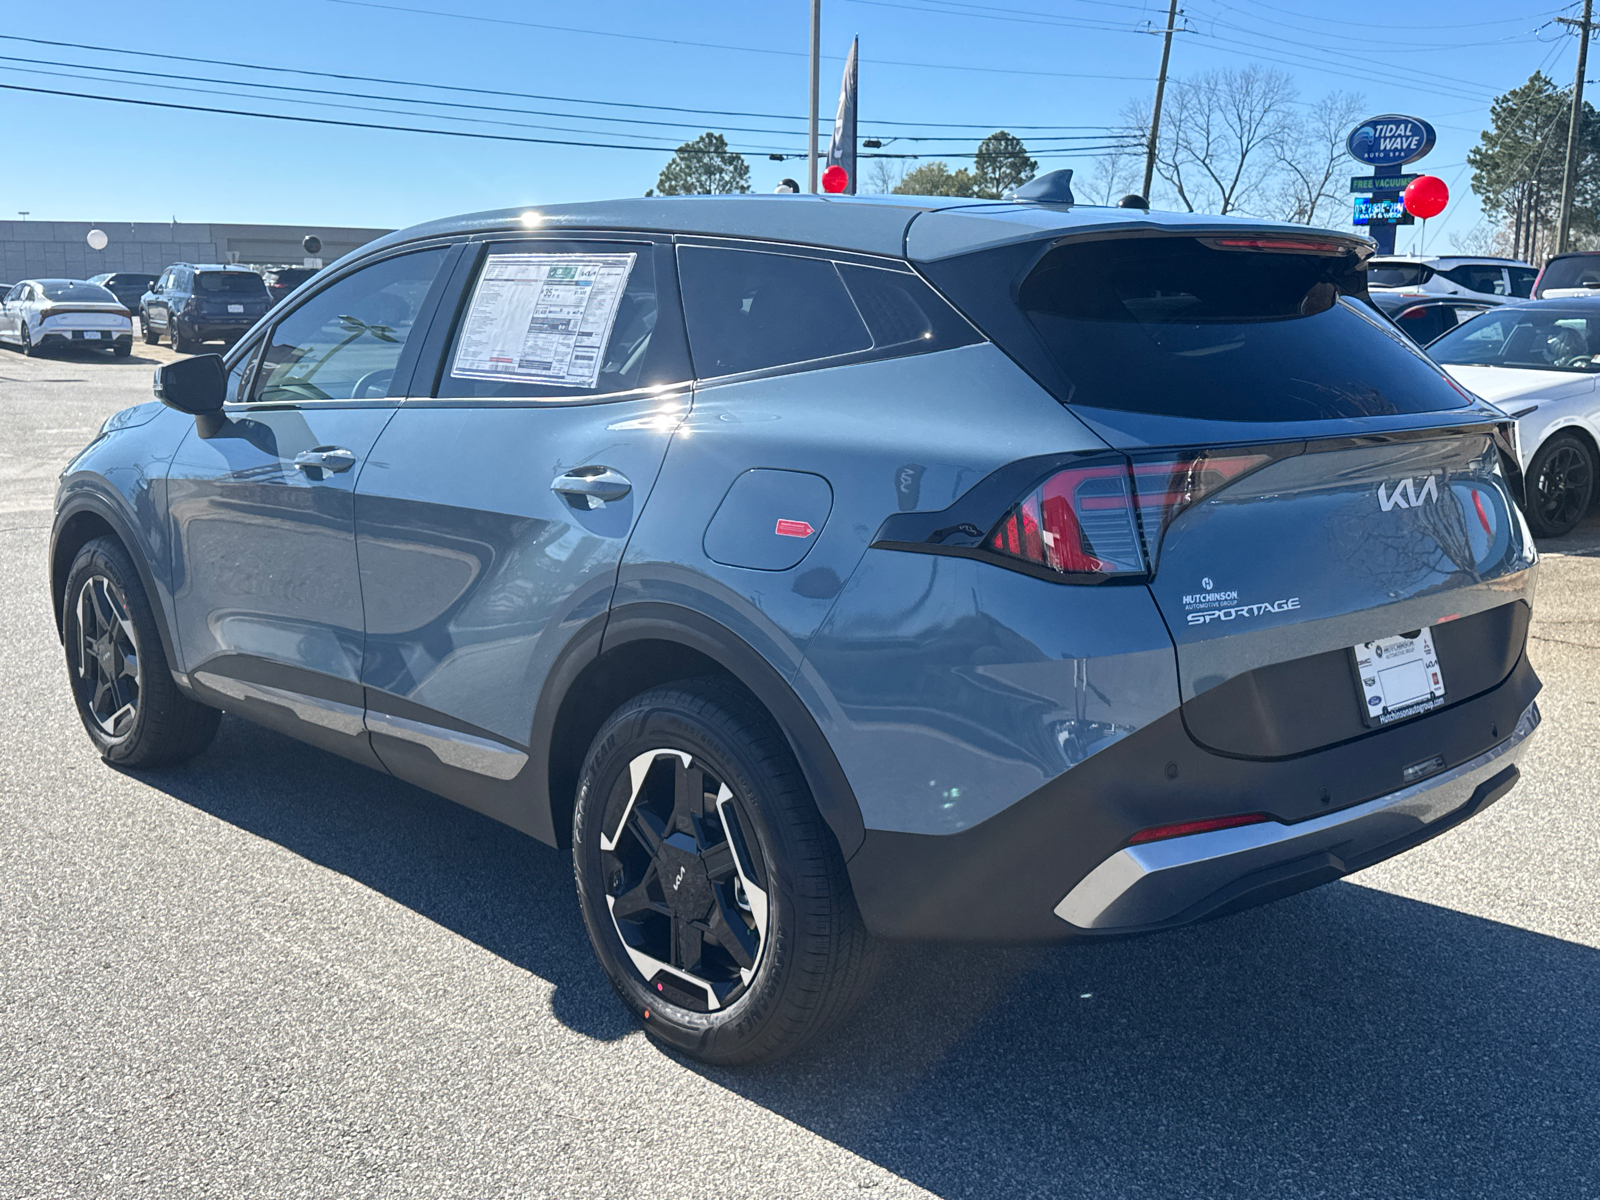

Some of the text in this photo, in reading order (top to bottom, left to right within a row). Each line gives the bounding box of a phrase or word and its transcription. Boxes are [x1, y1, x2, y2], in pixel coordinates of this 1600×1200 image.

[1375, 123, 1412, 137] TIDAL
[1379, 136, 1420, 151] WAVE
[1353, 179, 1373, 189] FREE
[1377, 475, 1438, 512] KIA
[1182, 590, 1238, 604] HUTCHINSON
[1185, 599, 1238, 610] AUTOMOTIVE GROUP
[1187, 597, 1301, 625] SPORTAGE
[672, 866, 686, 891] KIA
